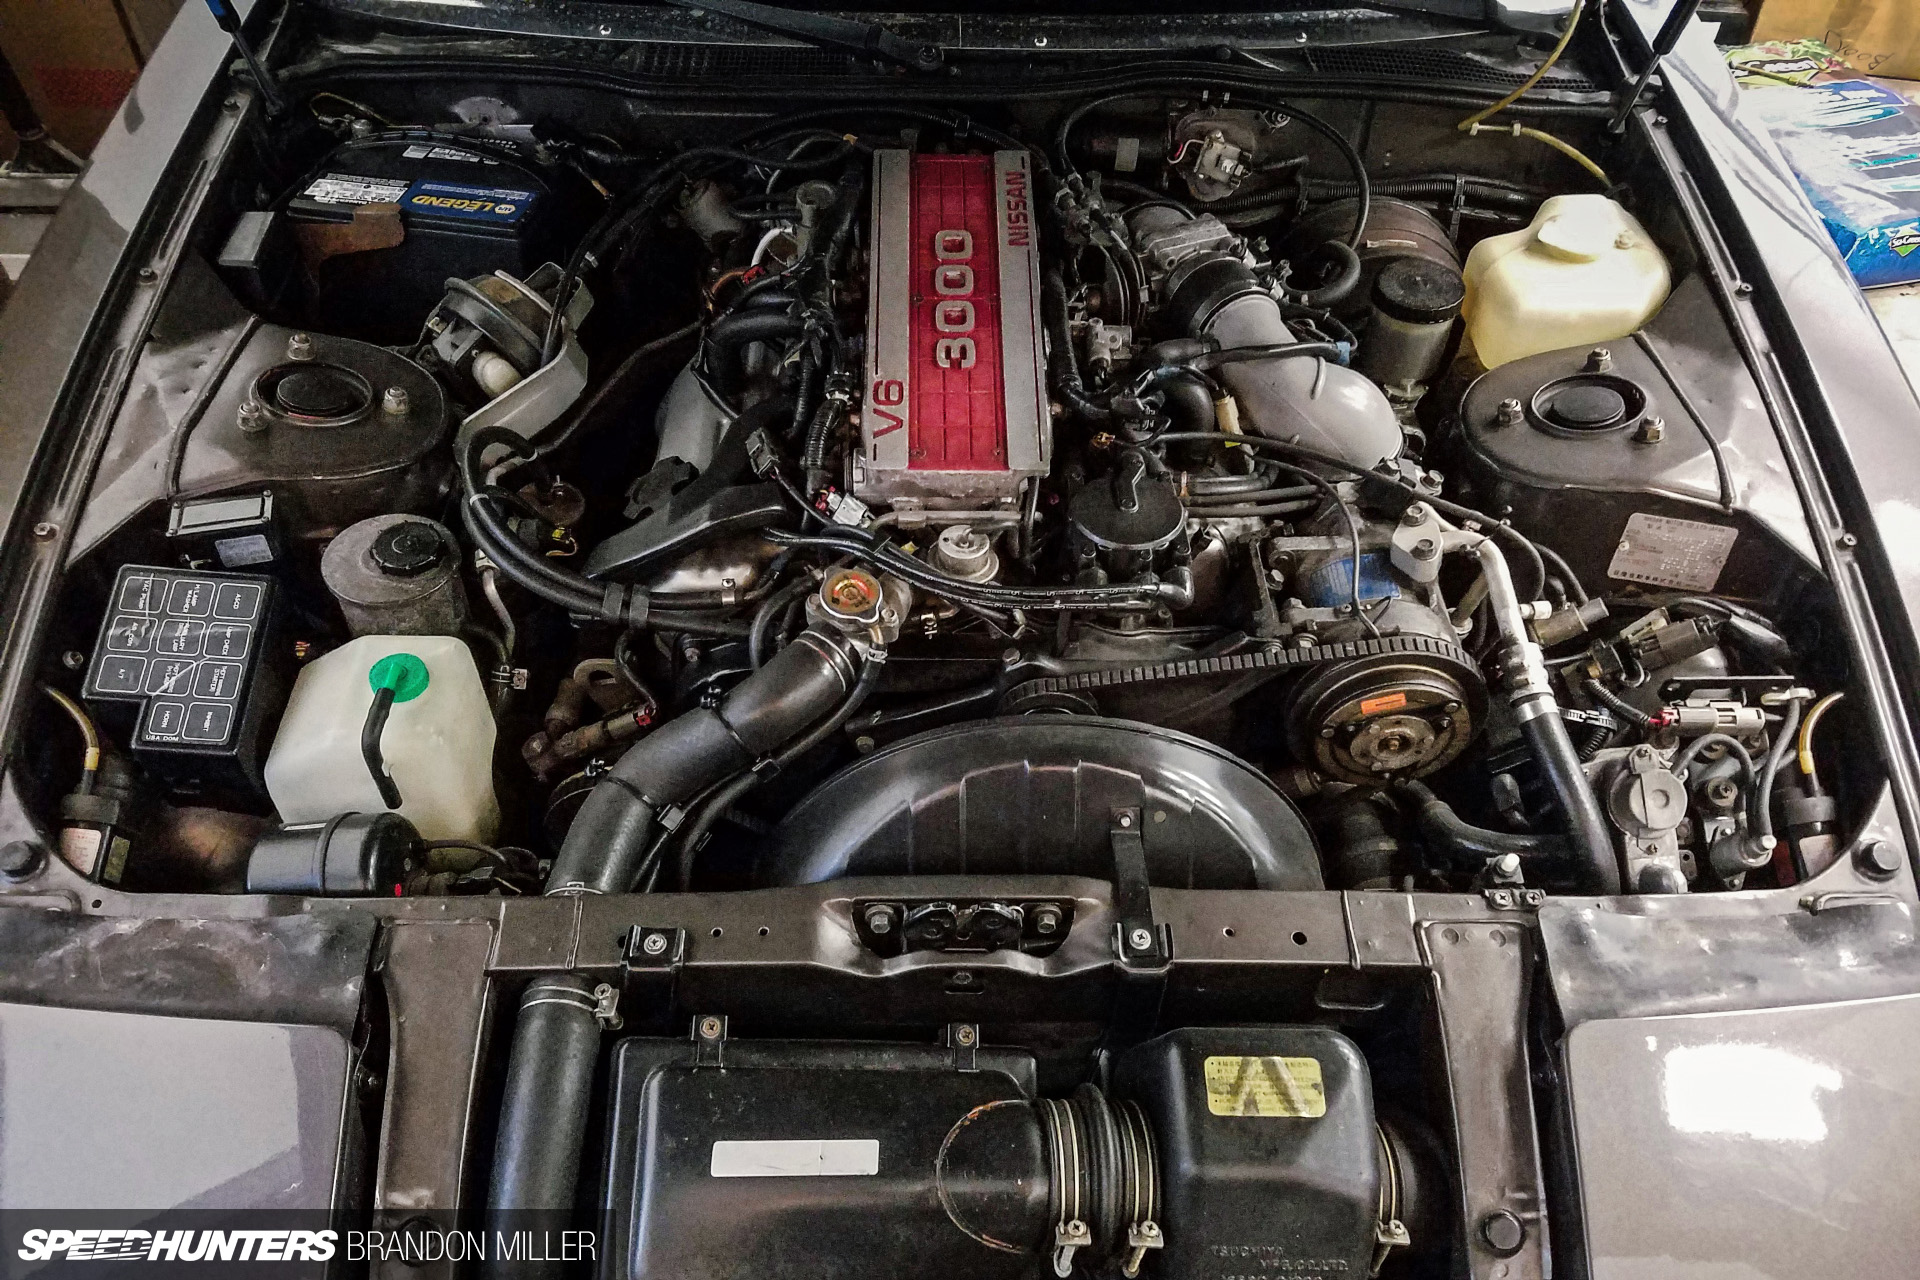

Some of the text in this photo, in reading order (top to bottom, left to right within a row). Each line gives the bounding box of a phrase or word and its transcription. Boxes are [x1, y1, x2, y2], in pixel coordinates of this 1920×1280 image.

[411, 194, 495, 212] LEGEND
[1005, 170, 1029, 247] NISSAN
[935, 229, 976, 371] 3000
[872, 379, 905, 439] V6
[142, 580, 151, 592] VAC
[160, 710, 171, 728] HORN
